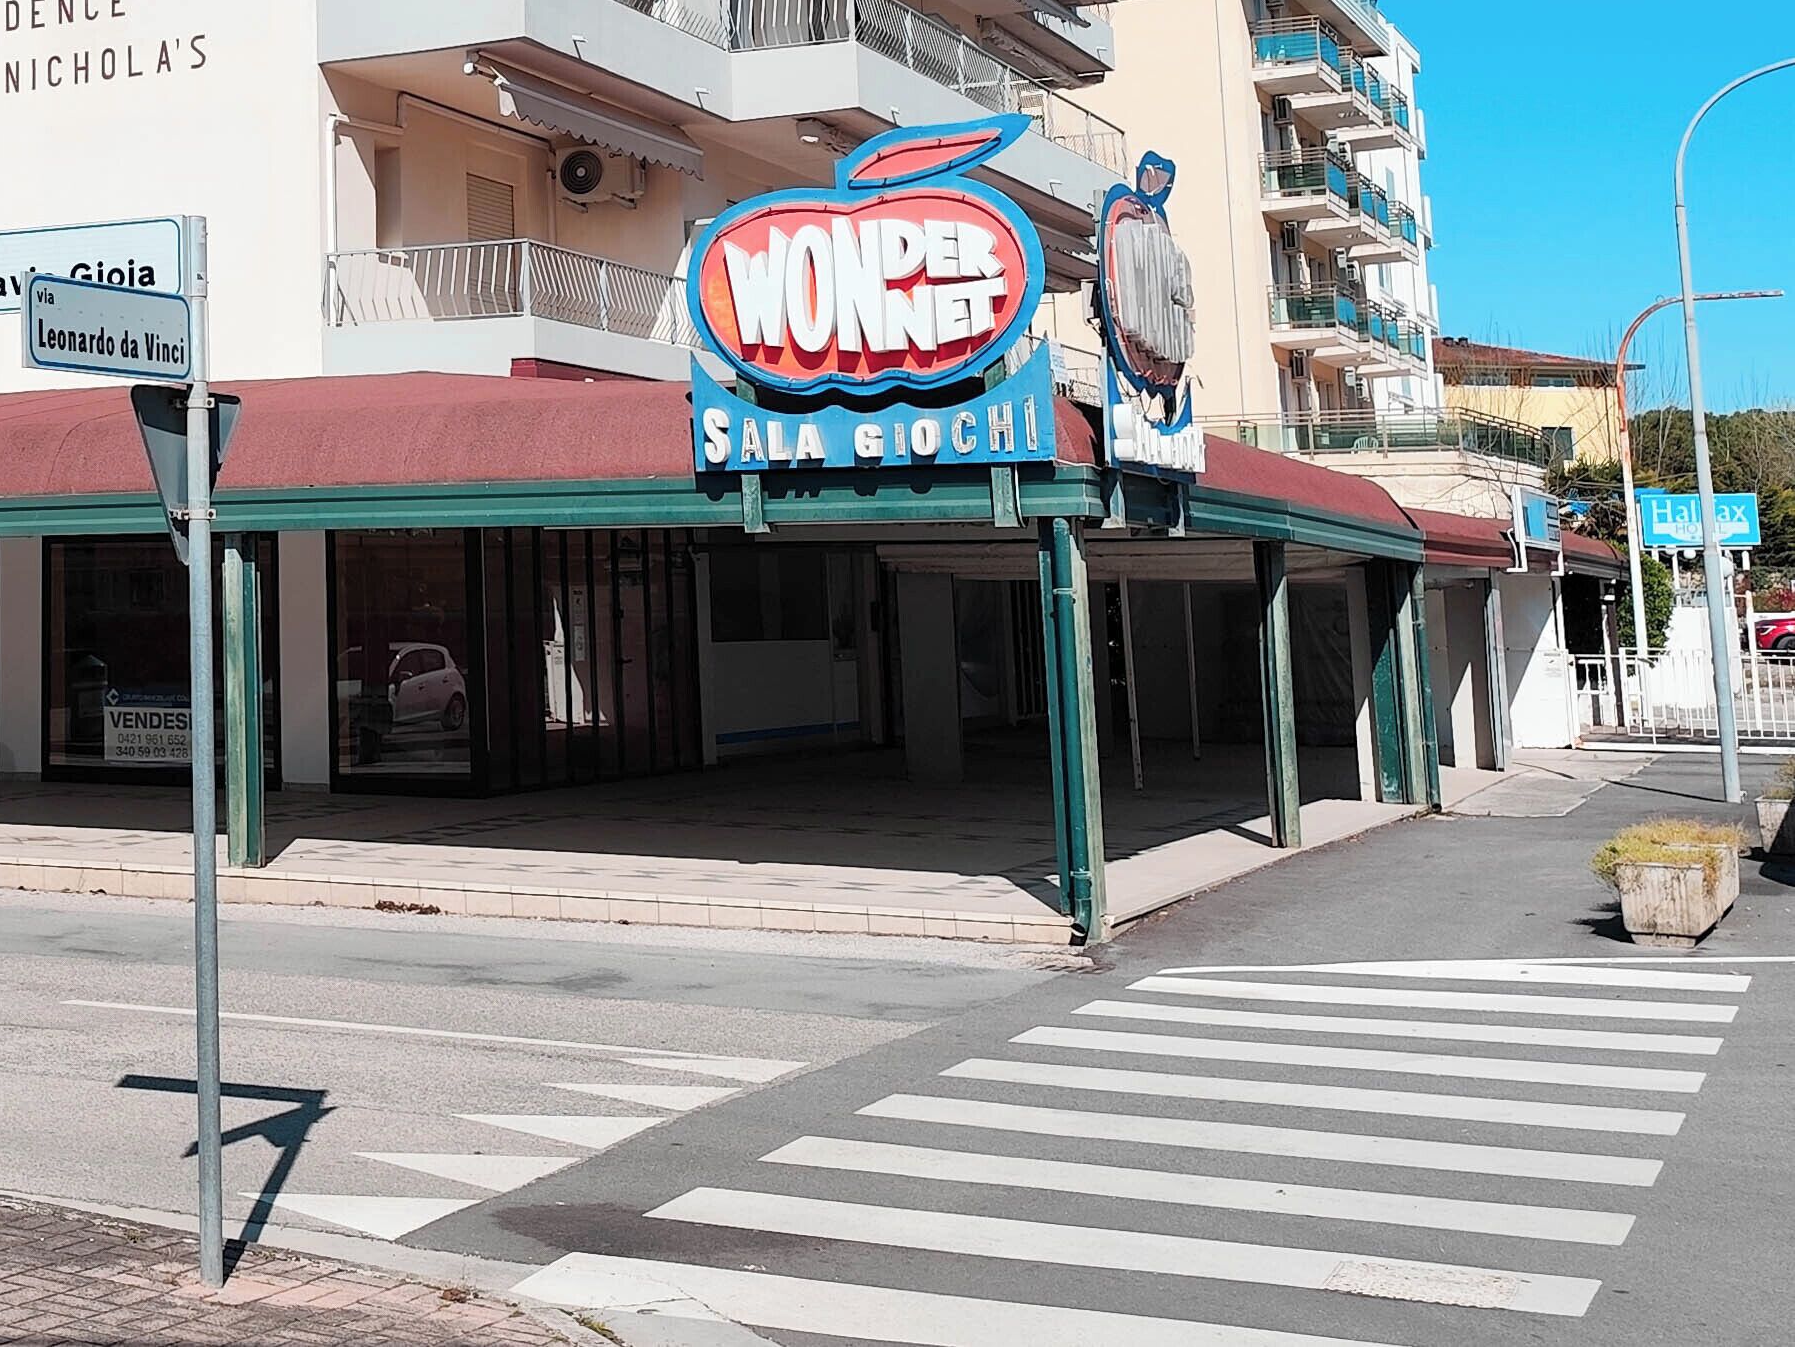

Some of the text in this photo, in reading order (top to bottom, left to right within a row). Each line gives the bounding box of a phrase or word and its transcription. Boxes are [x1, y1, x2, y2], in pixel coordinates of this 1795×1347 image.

[5, 33, 207, 94] NICHOLA'S
[36, 287, 55, 305] via
[69, 258, 156, 287] Gioia
[722, 217, 1006, 353] WONDER
[885, 276, 1007, 352] NET
[37, 317, 185, 365] Leonardo da Vinci
[703, 394, 1039, 465] SALA GIOCHI
[1651, 498, 1747, 523] Halax
[1675, 522, 1727, 534] HOL
